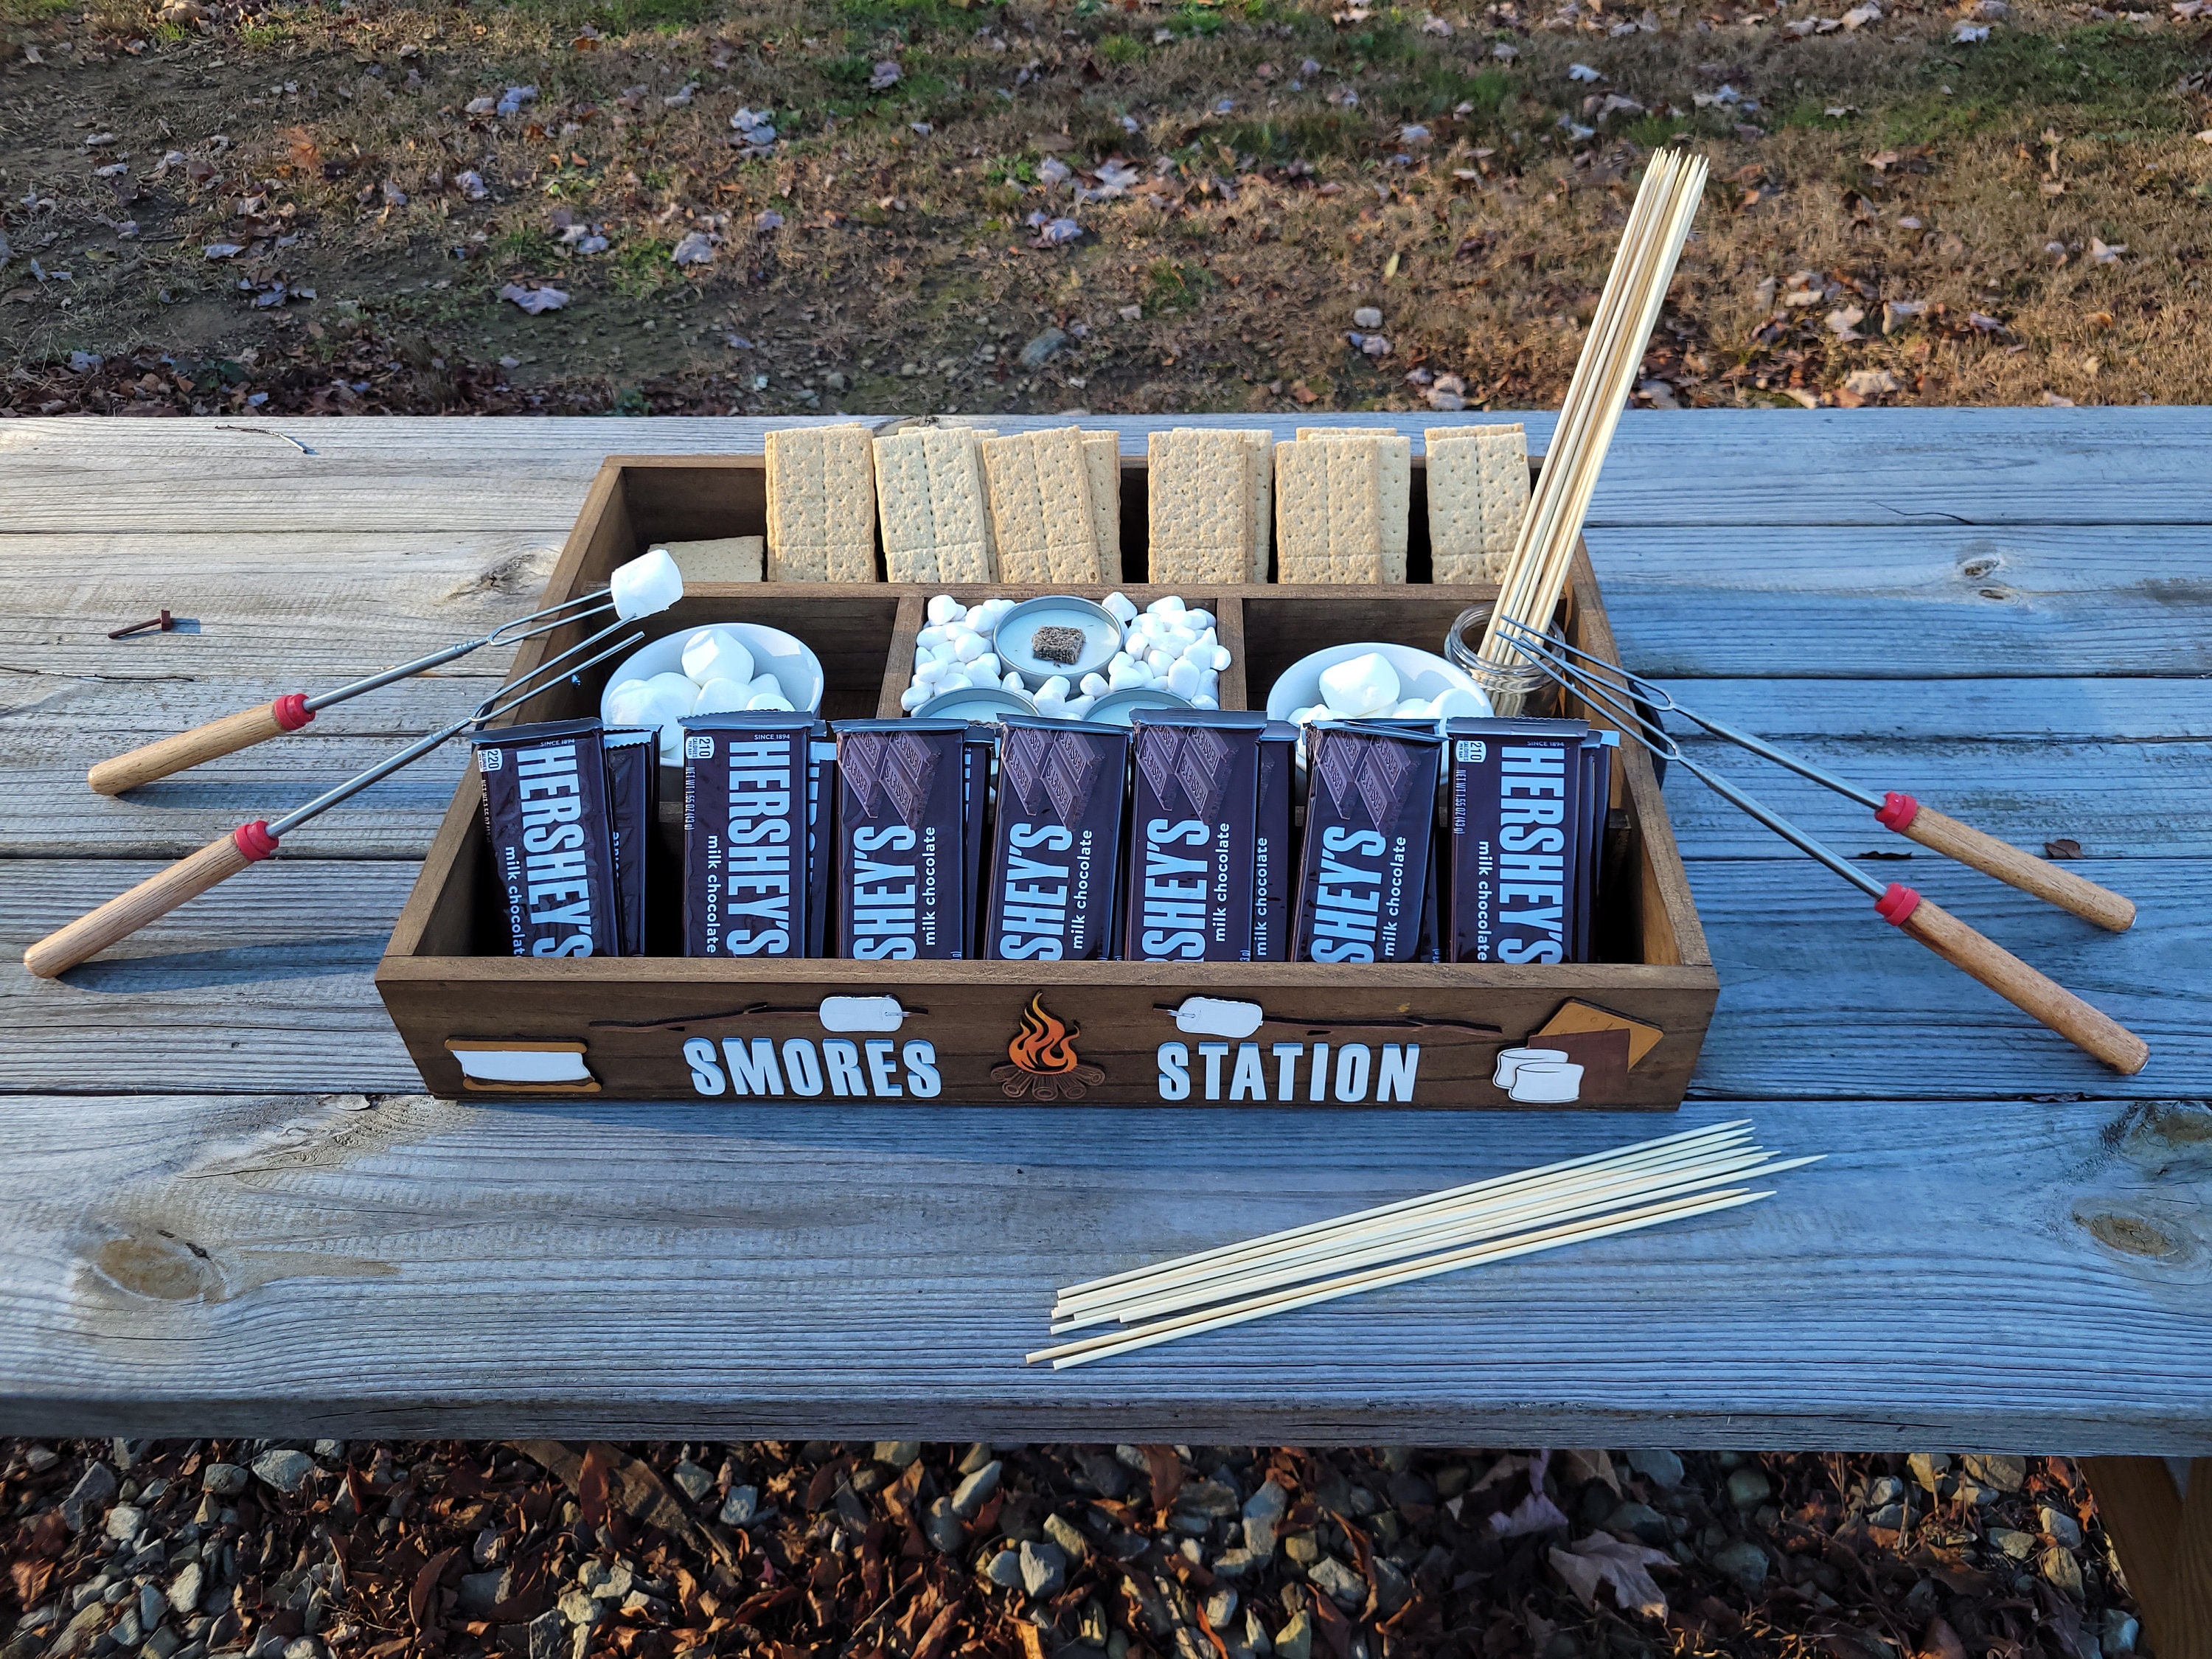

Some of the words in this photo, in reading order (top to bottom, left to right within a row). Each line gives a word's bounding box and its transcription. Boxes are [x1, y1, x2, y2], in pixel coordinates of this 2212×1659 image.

[487, 750, 499, 769] 220
[699, 738, 711, 757] 210
[1470, 742, 1482, 760] 210
[686, 767, 695, 779] NET
[686, 779, 695, 789] WT
[1455, 769, 1466, 781] NET
[1455, 782, 1466, 792] WT
[685, 804, 695, 812] OZ
[686, 790, 695, 803] 1.55
[1455, 793, 1466, 806] 1.55
[1455, 807, 1466, 815] OZ
[506, 846, 521, 880] milk
[517, 745, 594, 957] HERSHEY'S
[708, 835, 722, 869] milk
[727, 741, 791, 954] HERSHEY'S
[1214, 823, 1230, 902] chocolate
[1478, 841, 1493, 876] milk
[1498, 746, 1565, 964] HERSHEY'S
[922, 827, 936, 905] chocolate
[1074, 830, 1093, 909] chocolate
[1255, 838, 1267, 916] chocolate
[1386, 836, 1406, 916] chocolate
[1141, 818, 1210, 961] SHEY'S
[509, 885, 525, 957] chocolat
[706, 874, 721, 953] chocolate
[922, 911, 936, 945] milk
[1212, 908, 1226, 942] milk
[1477, 881, 1492, 961] chocolate
[1071, 915, 1085, 949] milk
[1254, 921, 1267, 956] milk
[1382, 922, 1398, 956] milk
[683, 1037, 942, 1098] SMORES
[1157, 1041, 1419, 1102] STATION
